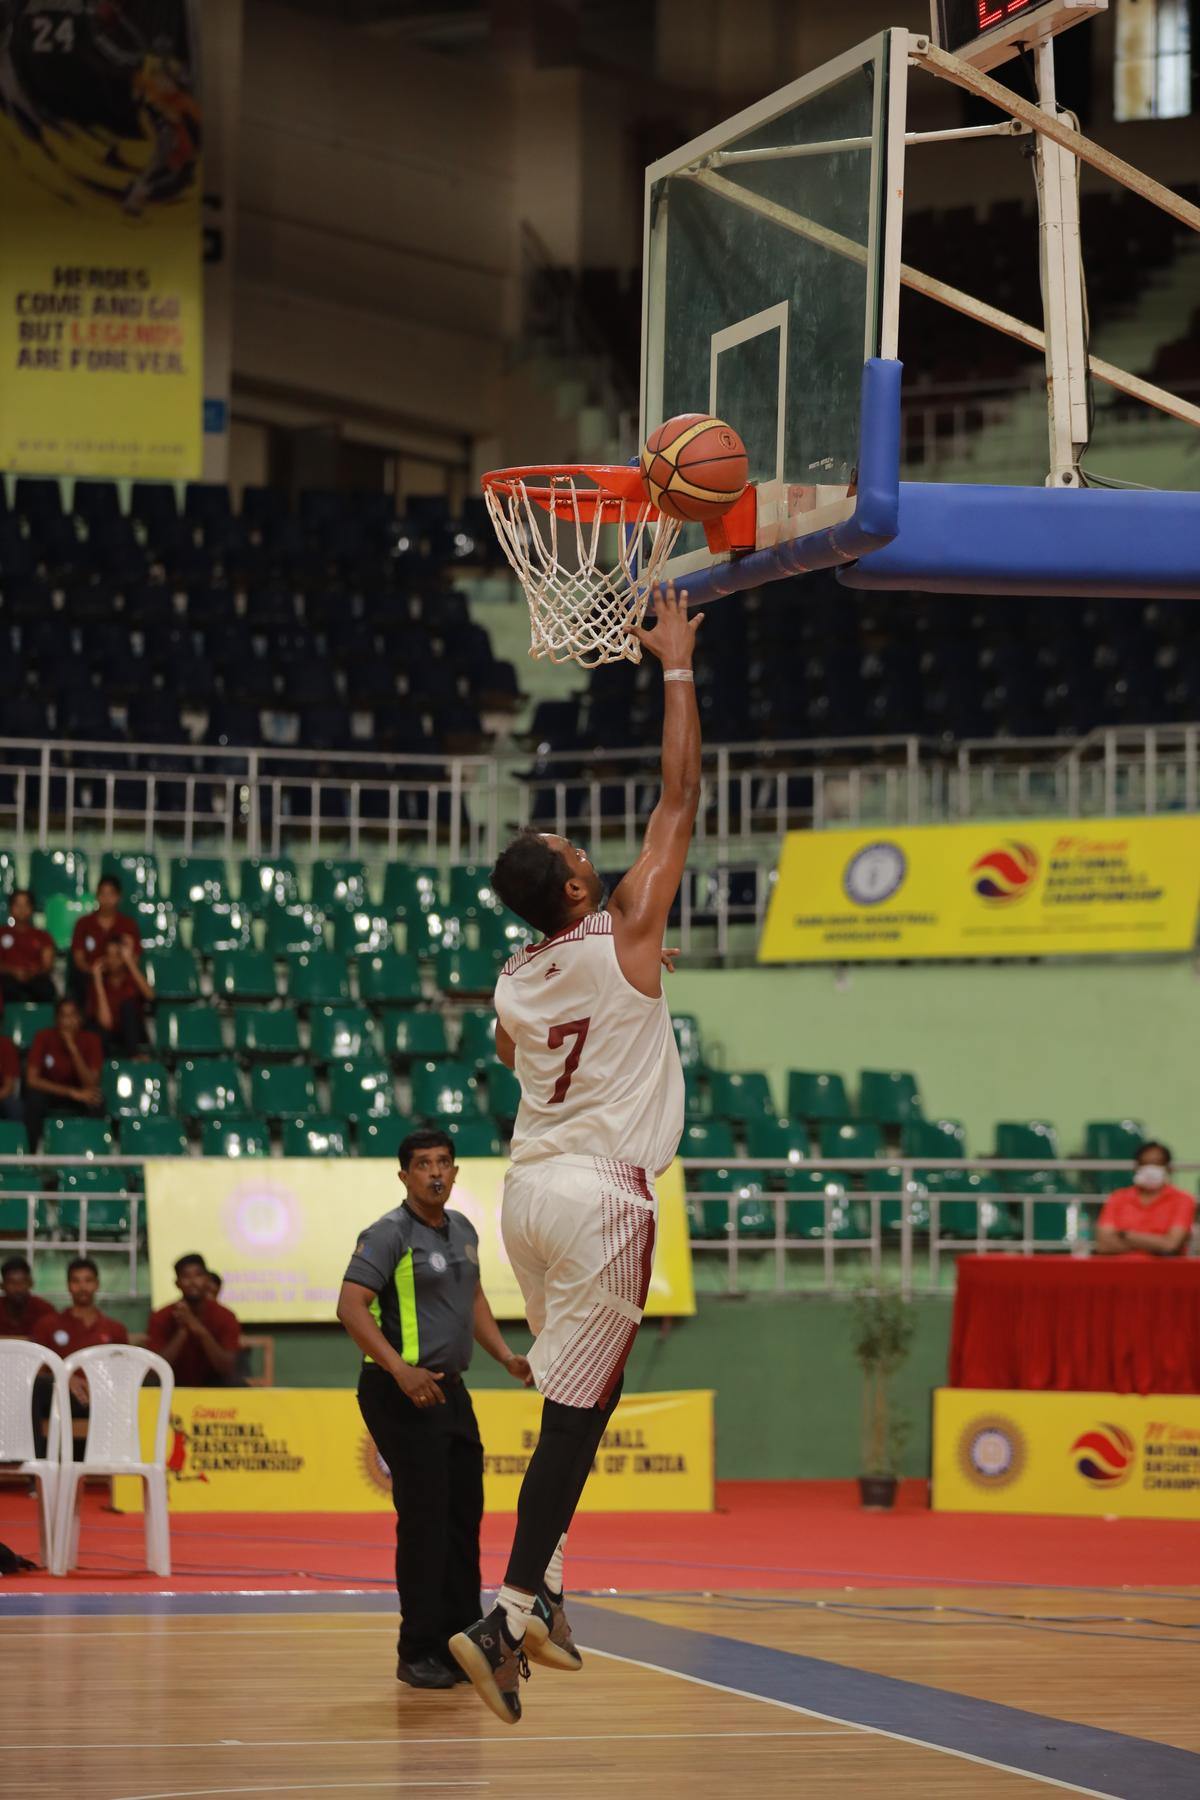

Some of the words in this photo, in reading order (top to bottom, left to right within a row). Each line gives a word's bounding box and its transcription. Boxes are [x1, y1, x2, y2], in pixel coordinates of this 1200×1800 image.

[32, 18, 74, 53] 24
[54, 267, 150, 290] HEROES
[16, 292, 81, 316] COME
[92, 295, 142, 316] AND
[148, 297, 180, 319] GO
[19, 321, 63, 342] BUT
[71, 321, 183, 346] LEGENDS
[17, 348, 62, 370] ARE
[547, 1017, 591, 1104] 7
[193, 1423, 264, 1437] NATIONAL
[192, 1440, 288, 1454] BASKETBALL
[191, 1456, 305, 1471] CHAMPIONSHIP
[605, 1455, 626, 1474] OF
[633, 1455, 687, 1474] INDIA
